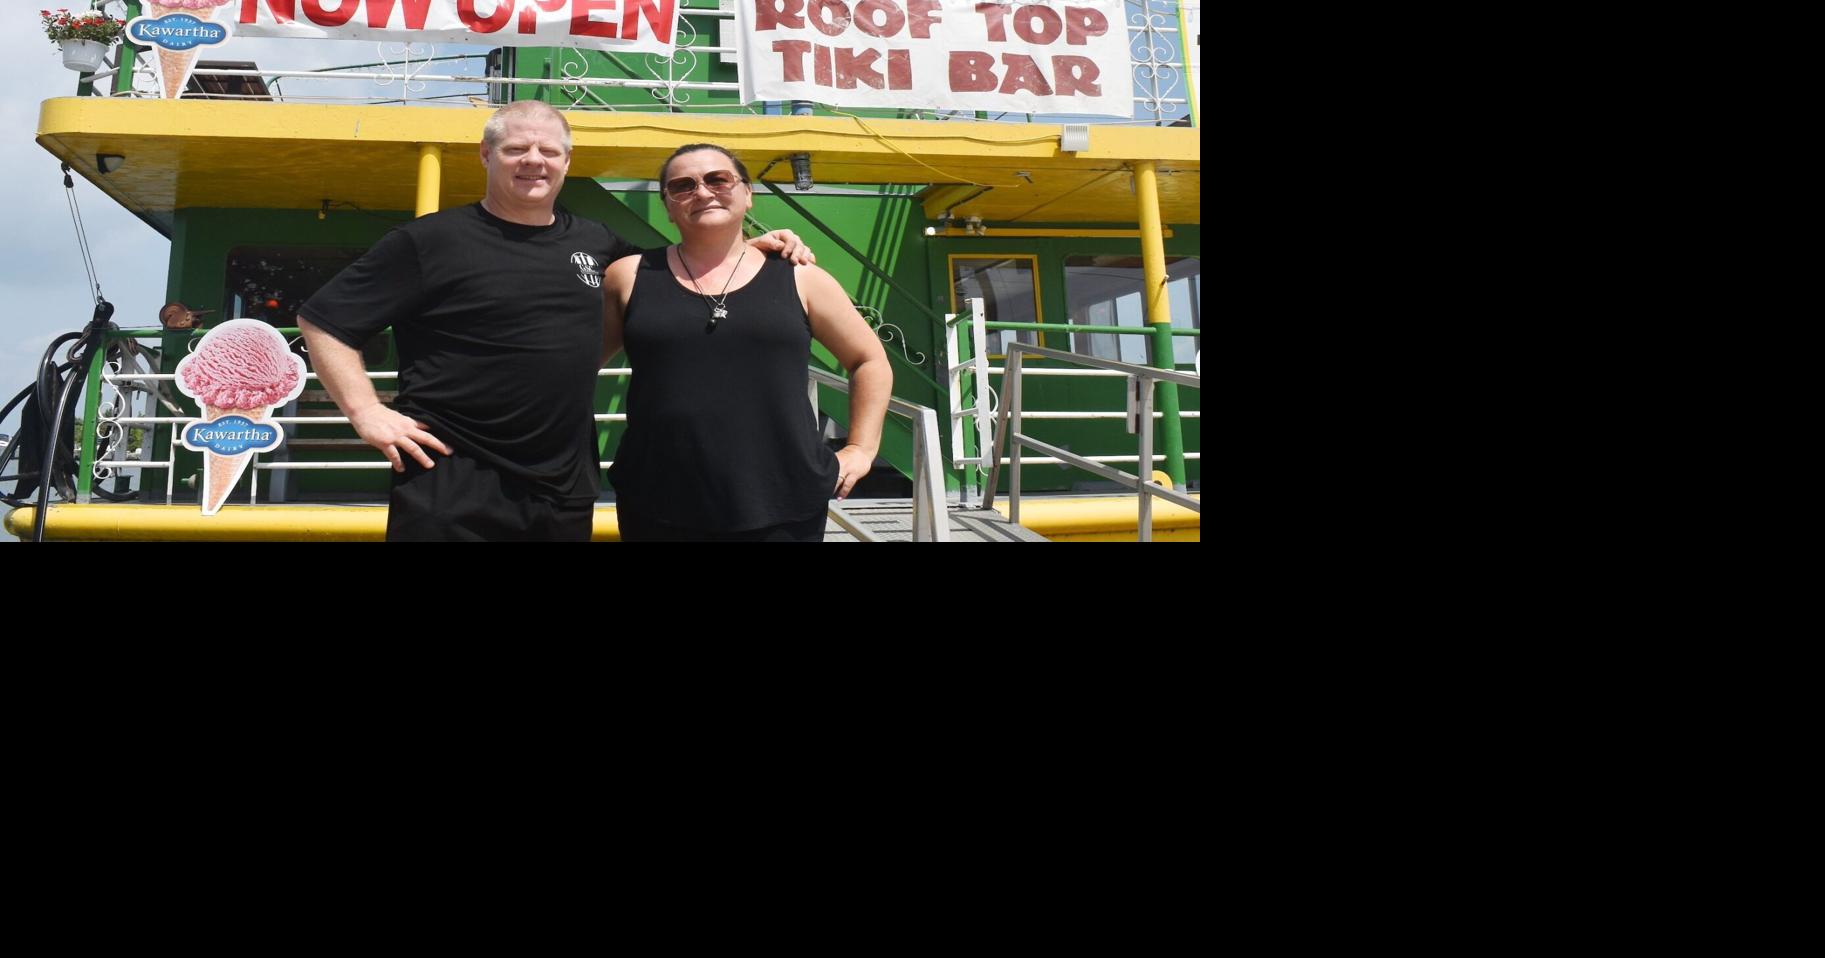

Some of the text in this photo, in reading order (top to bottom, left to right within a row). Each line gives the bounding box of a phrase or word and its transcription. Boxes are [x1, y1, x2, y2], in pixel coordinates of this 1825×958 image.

[138, 23, 219, 38] Kawartha
[755, 0, 1109, 45] ROOF TOP
[772, 39, 1103, 97] TIKI BAR
[193, 428, 270, 442] Kawartha
